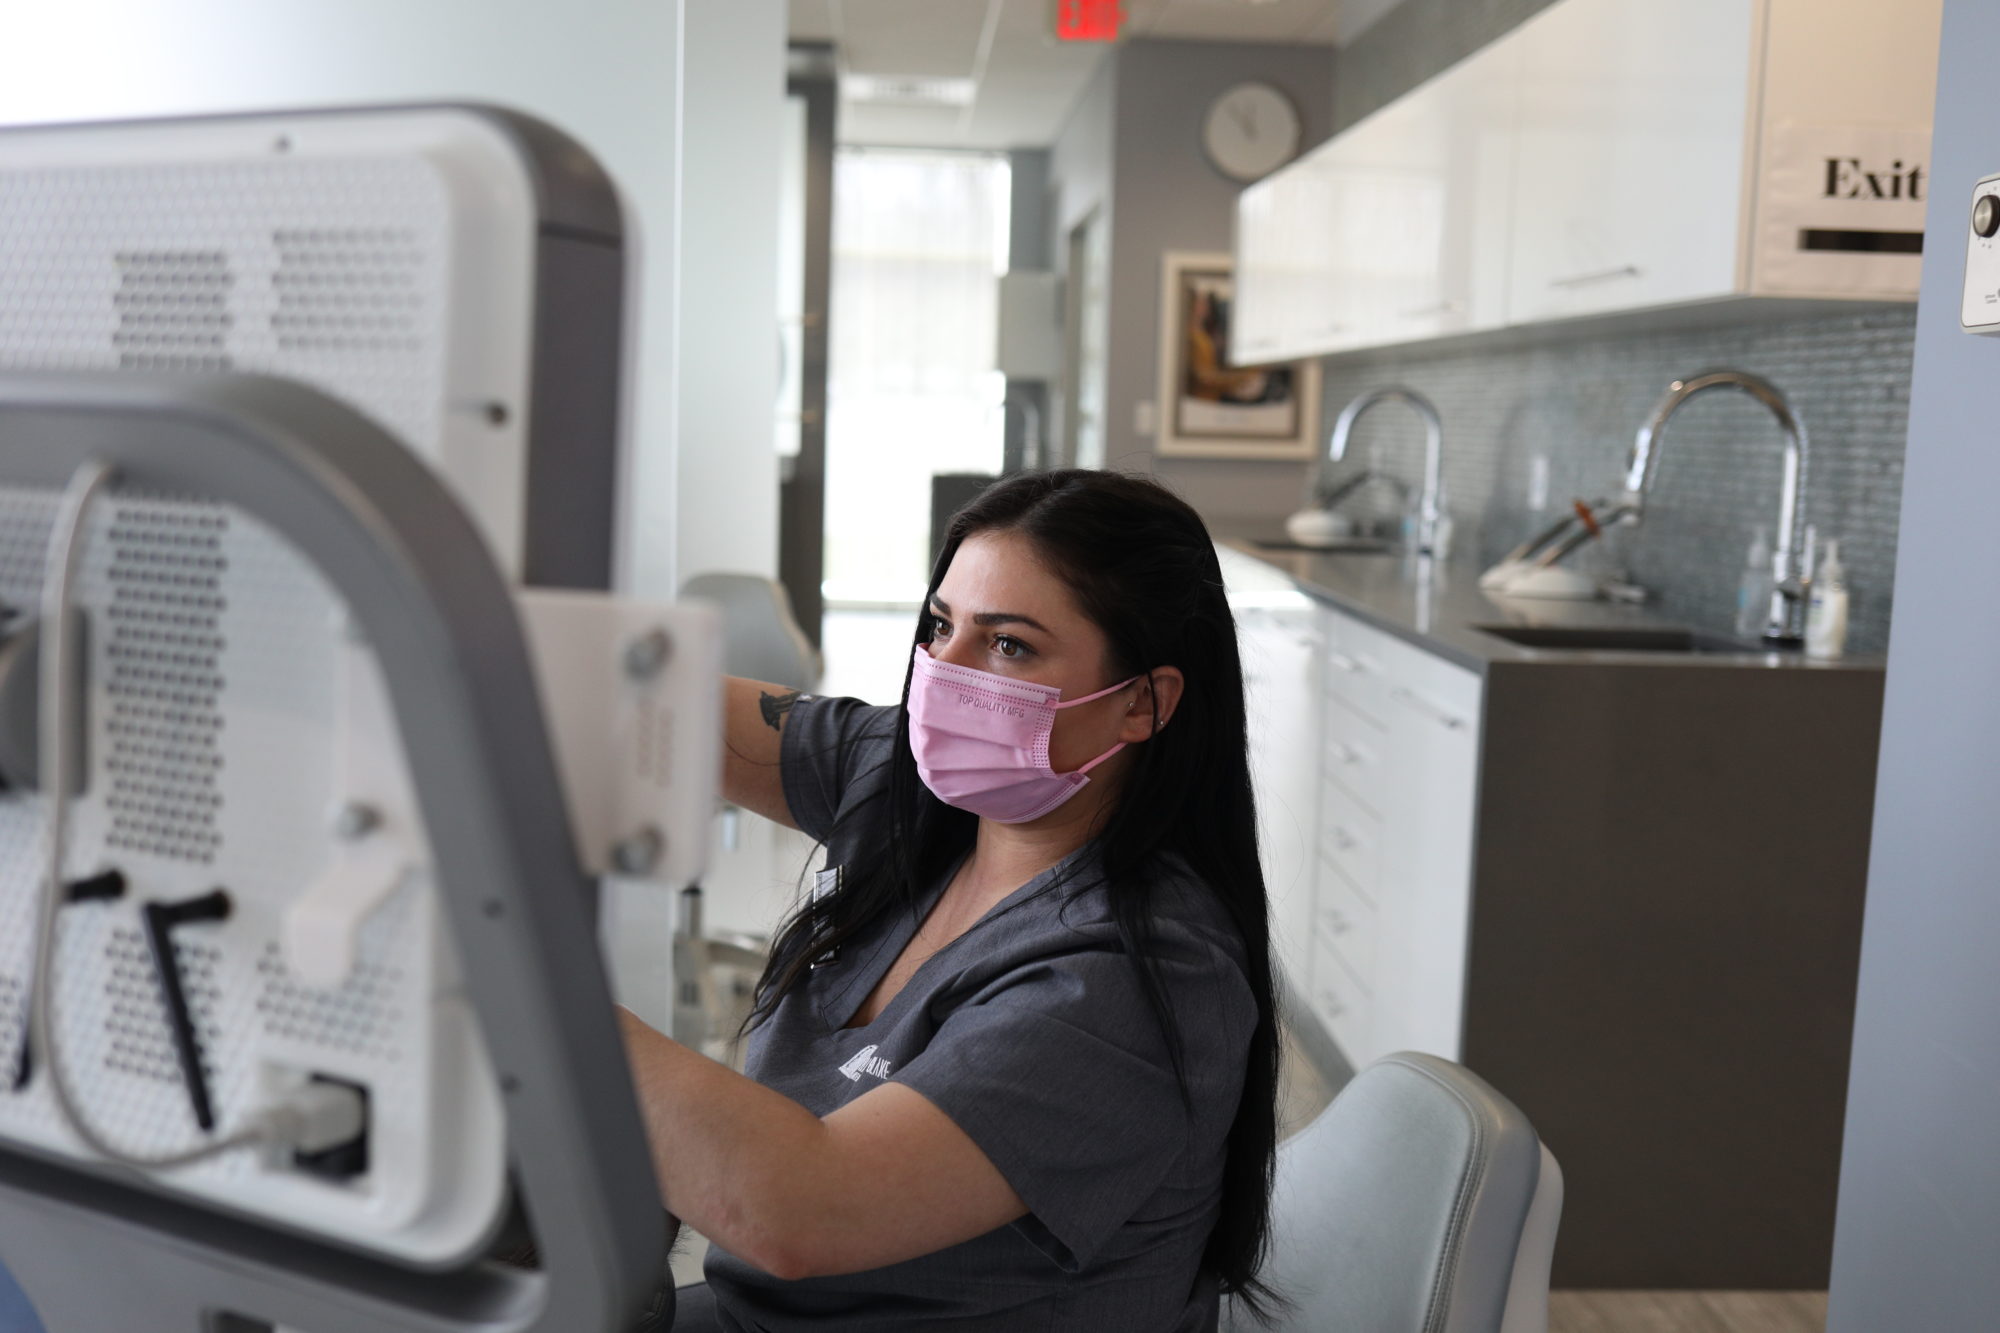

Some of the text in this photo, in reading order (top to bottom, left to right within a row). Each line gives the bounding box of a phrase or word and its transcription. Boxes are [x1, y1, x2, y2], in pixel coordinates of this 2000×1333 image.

[1824, 157, 1926, 200] Exit
[959, 693, 1025, 718] TOP QUALITY MFG
